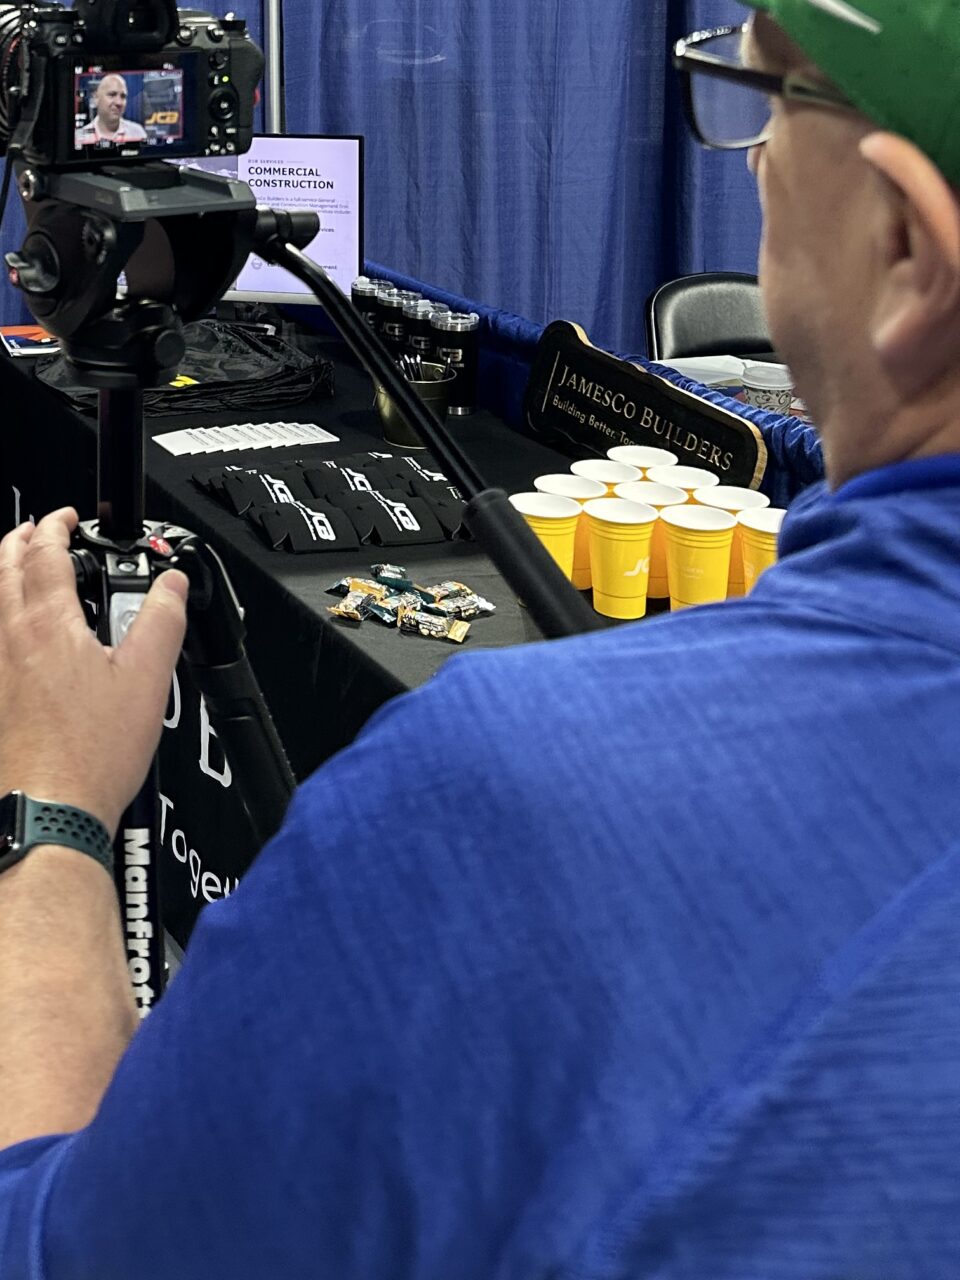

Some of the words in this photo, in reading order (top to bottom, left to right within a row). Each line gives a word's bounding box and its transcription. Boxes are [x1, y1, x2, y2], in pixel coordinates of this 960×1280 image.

[248, 166, 321, 177] COMMERCIAL
[248, 178, 334, 189] CONSTRUCTION
[552, 394, 586, 424] Building
[589, 414, 616, 439] Better.
[558, 365, 637, 419] JAMESCO
[640, 406, 734, 471] BUILDERS
